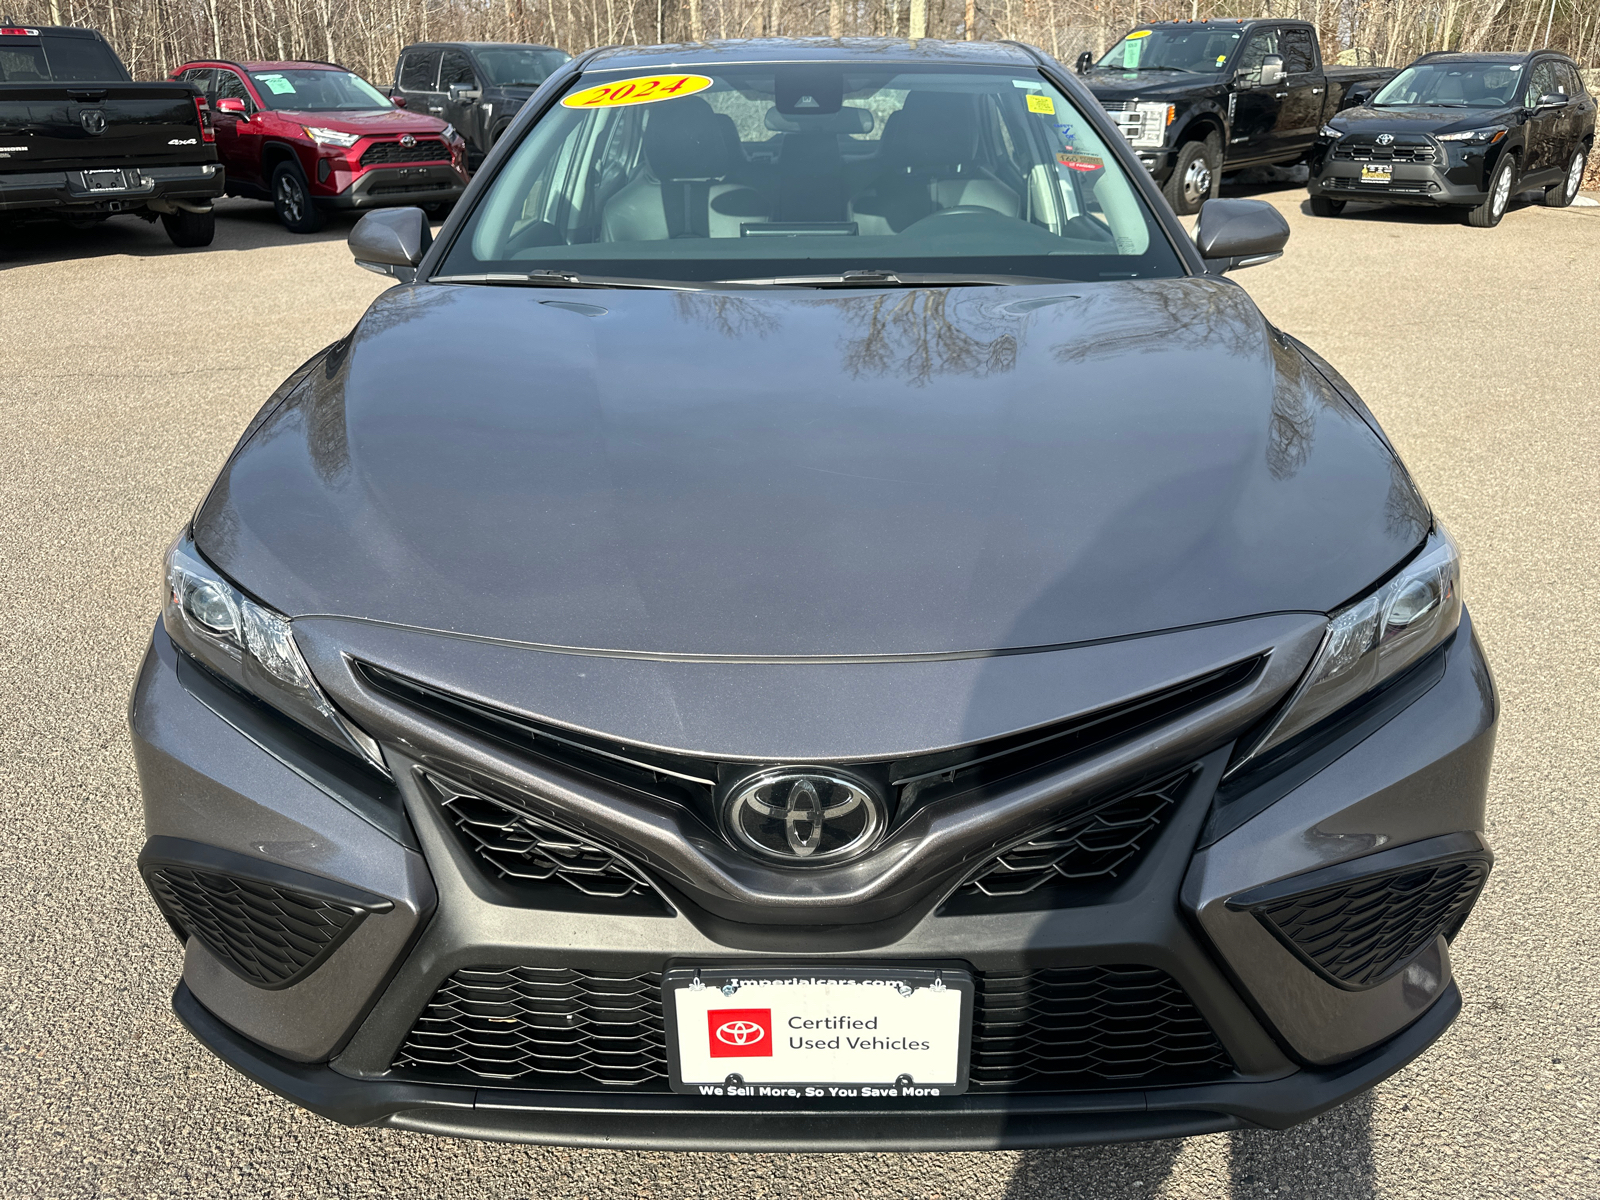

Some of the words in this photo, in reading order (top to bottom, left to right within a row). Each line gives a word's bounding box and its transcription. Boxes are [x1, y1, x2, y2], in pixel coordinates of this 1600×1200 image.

[582, 77, 690, 106] 2024
[168, 138, 197, 146] 4x4
[788, 1016, 878, 1030] Certified
[789, 1036, 840, 1050] Used
[846, 1036, 930, 1051] Vehicles
[699, 1086, 724, 1096] We
[727, 1086, 754, 1097] Sell
[759, 1086, 801, 1099] More,
[805, 1086, 824, 1097] So
[829, 1087, 857, 1097] You
[861, 1087, 898, 1097] Save
[902, 1087, 940, 1097] More
